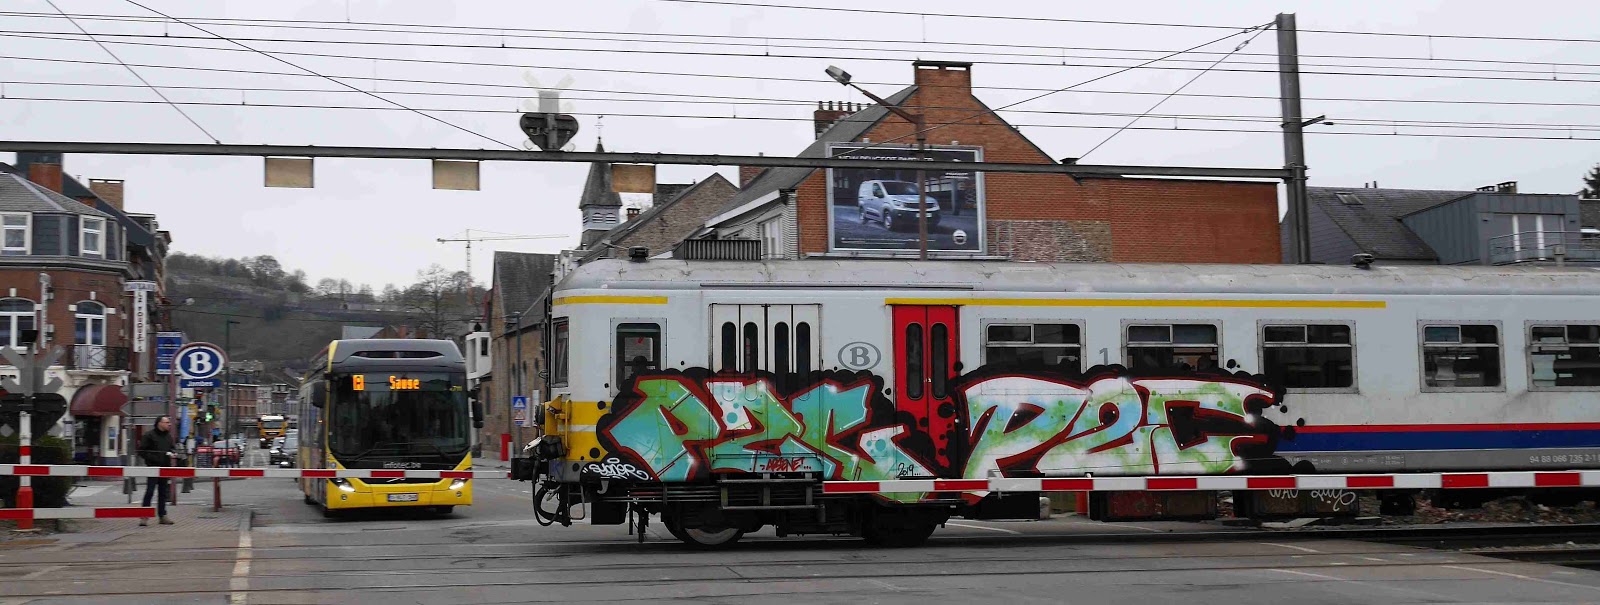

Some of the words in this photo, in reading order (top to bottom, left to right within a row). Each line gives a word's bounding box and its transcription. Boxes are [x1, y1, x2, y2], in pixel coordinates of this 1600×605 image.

[187, 351, 213, 374] B
[850, 346, 870, 366] B
[1099, 347, 1109, 366] 1
[1529, 455, 1540, 463] 94
[1568, 454, 1583, 464] 735
